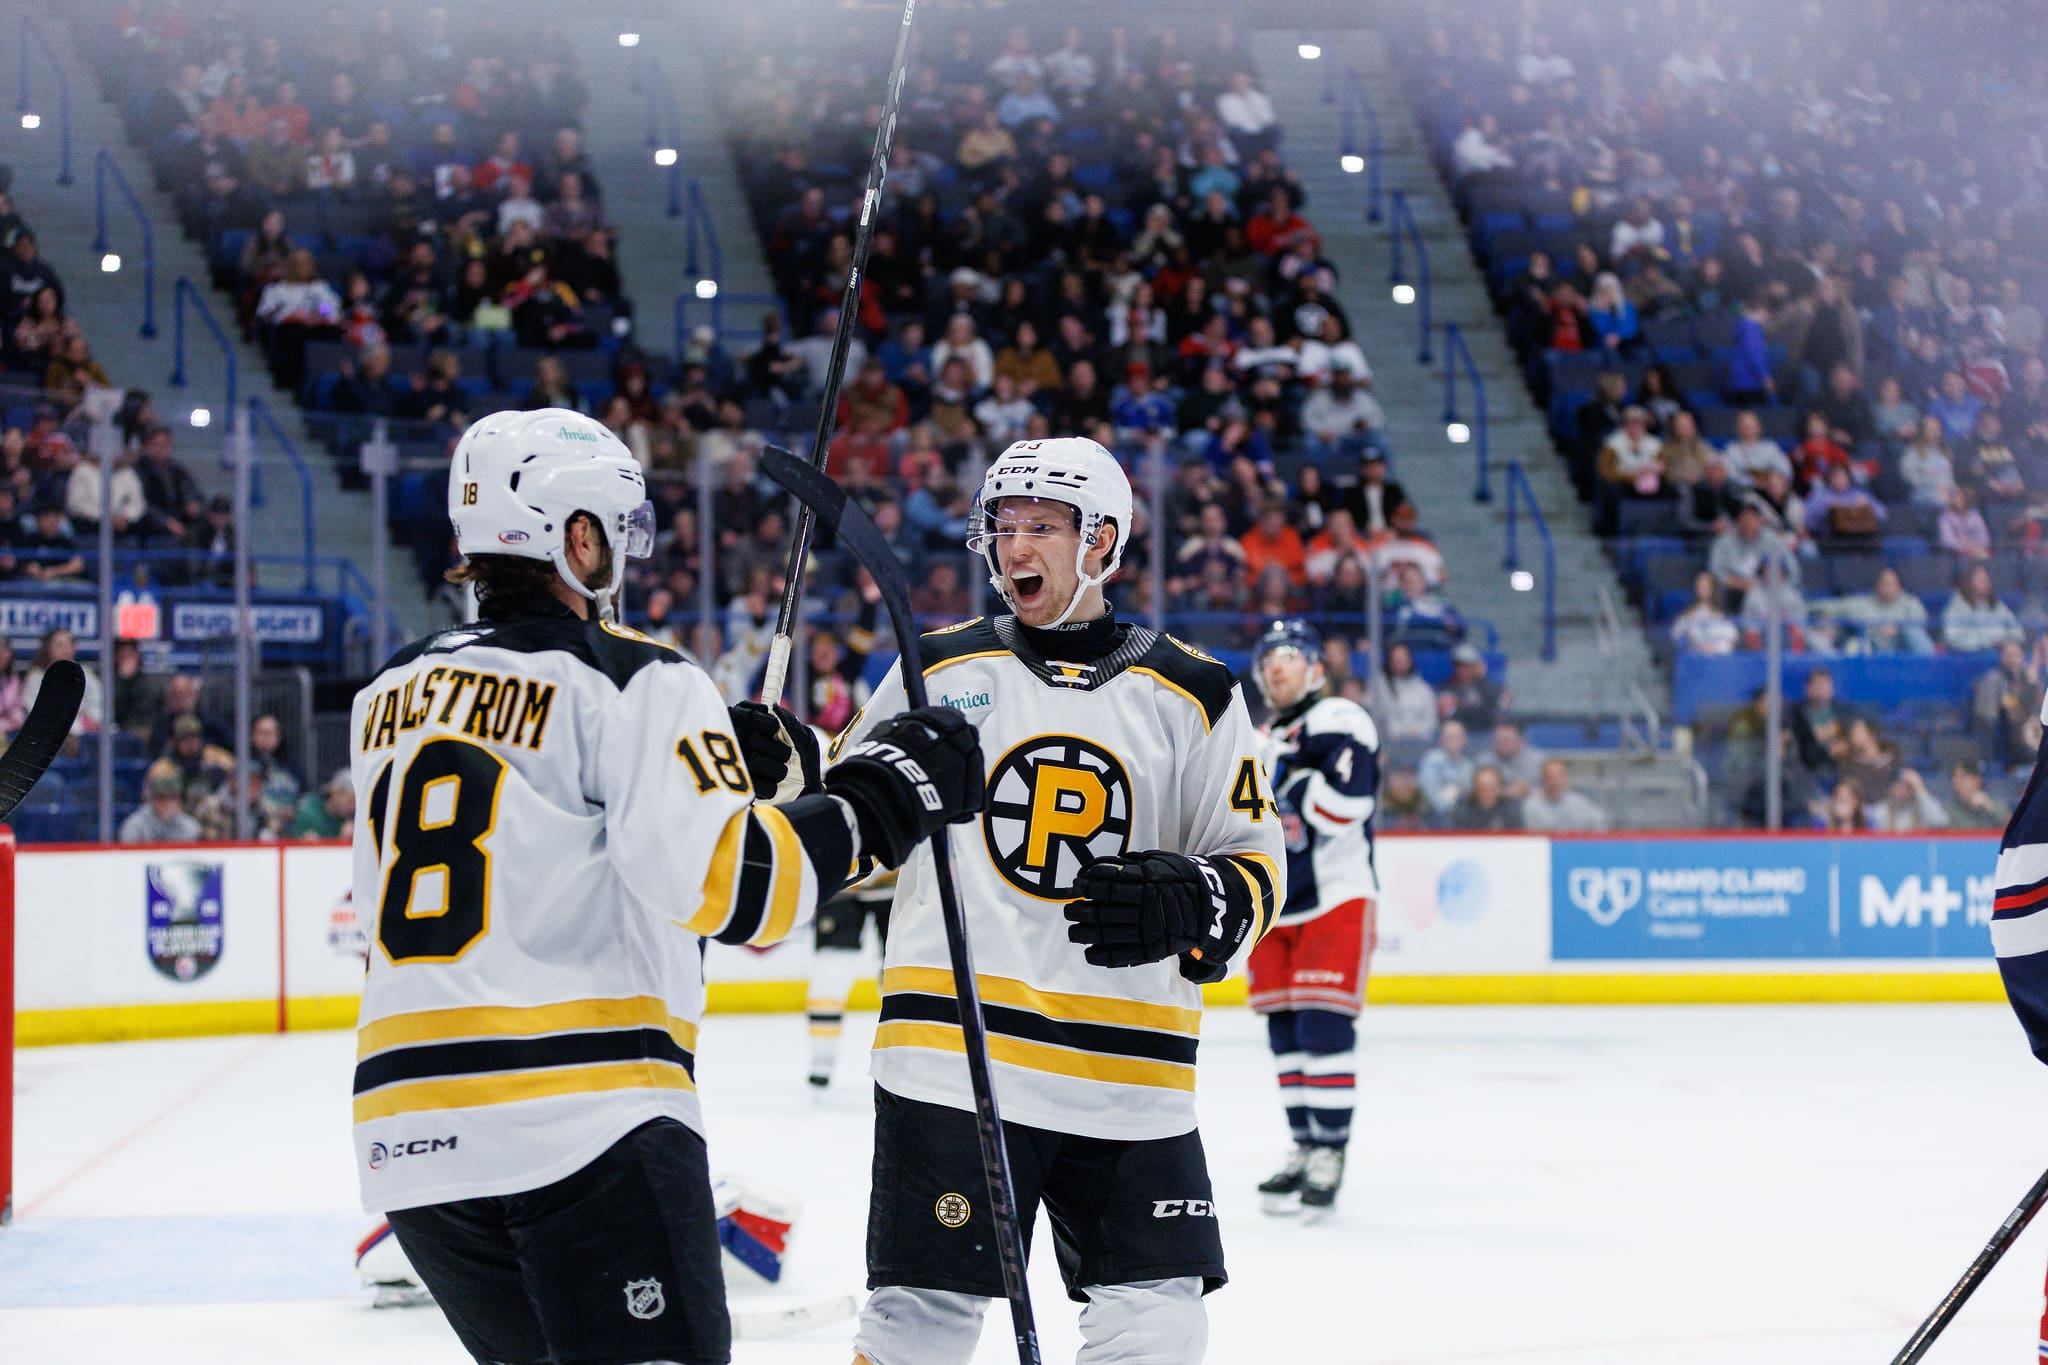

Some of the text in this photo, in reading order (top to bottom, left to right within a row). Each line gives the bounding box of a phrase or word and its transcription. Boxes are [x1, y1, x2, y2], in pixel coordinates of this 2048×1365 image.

[998, 466, 1040, 475] CCM
[463, 482, 478, 504] 18
[8, 607, 89, 629] LIGHT
[1050, 622, 1090, 632] UER
[941, 691, 991, 710] Amica
[676, 729, 753, 798] 18
[858, 740, 944, 811] BAU
[1335, 747, 1353, 784] 4
[1229, 757, 1281, 823] 4
[1025, 763, 1108, 867] P
[368, 734, 509, 967] 8
[1234, 918, 1249, 943] BRUINS
[392, 1136, 458, 1158] CCM
